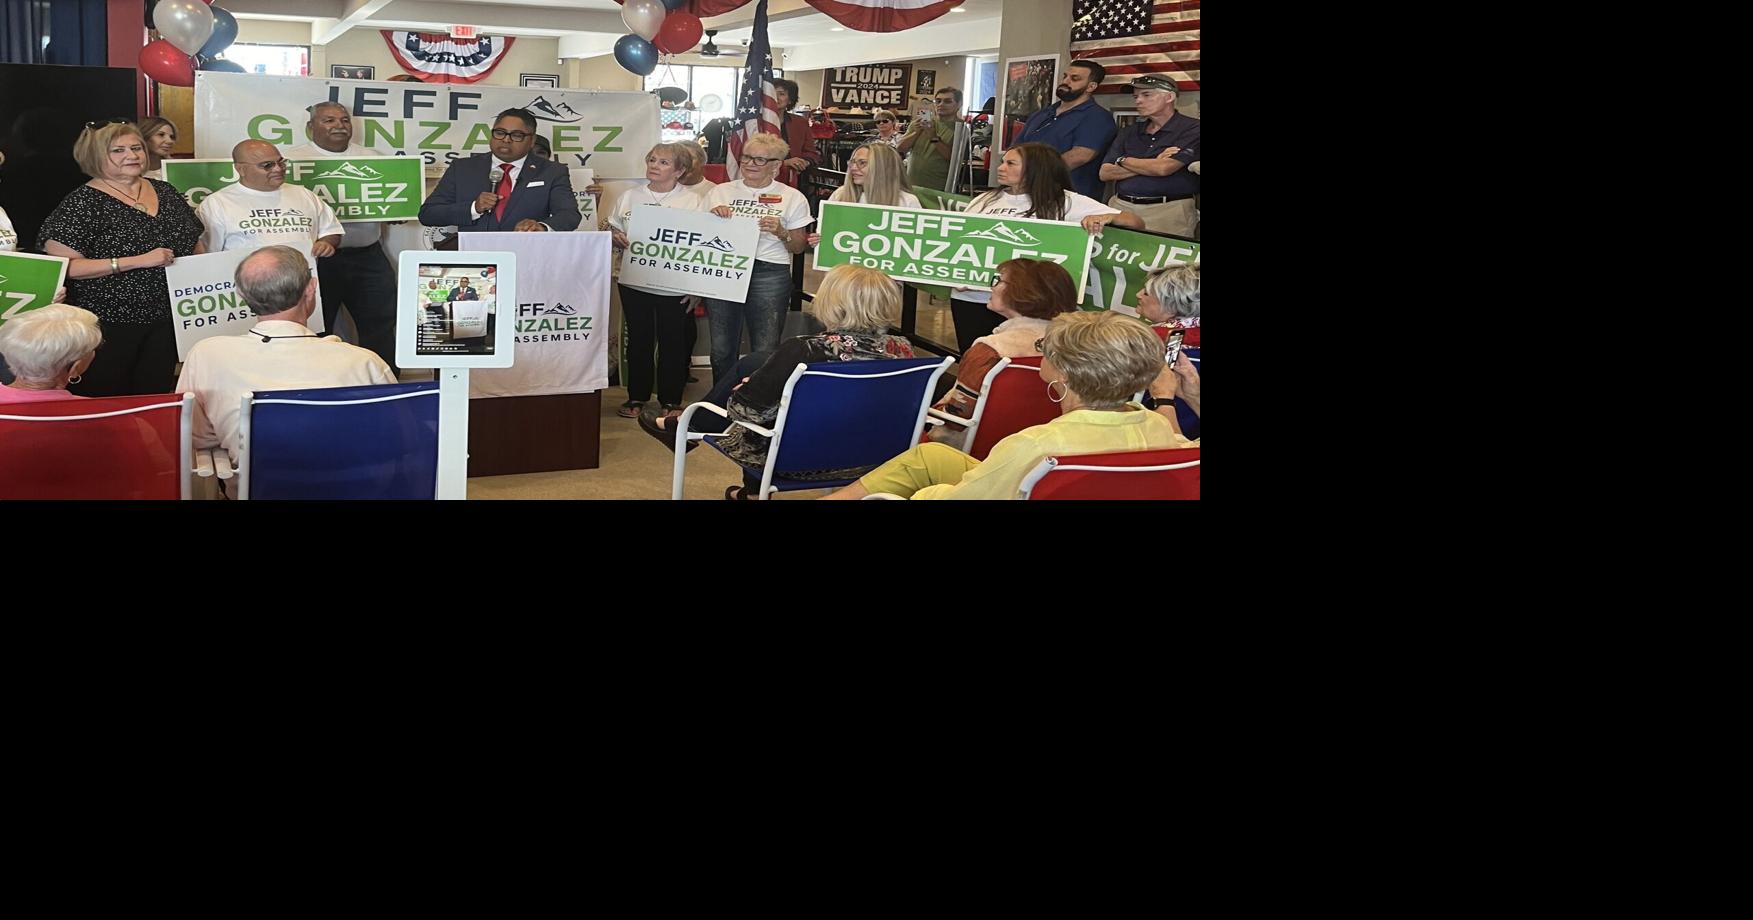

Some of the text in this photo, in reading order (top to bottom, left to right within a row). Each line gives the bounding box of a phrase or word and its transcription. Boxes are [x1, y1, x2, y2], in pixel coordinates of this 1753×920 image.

[833, 66, 903, 84] TRUMP
[831, 88, 902, 104] VANCE
[247, 114, 623, 152] GNZAEZ
[249, 209, 281, 217] JEFF
[239, 218, 312, 229] GONZALEZ
[868, 211, 966, 238] JEFF
[649, 228, 702, 246] JEFF
[630, 241, 749, 270] GONZALEZ
[850, 256, 895, 271] FOR
[1107, 244, 1141, 264] for
[1139, 244, 1200, 271] JE
[630, 256, 743, 280] FOR ASSEMBLY
[175, 281, 236, 297] DEMOCR
[183, 316, 217, 330] FOR
[515, 317, 592, 332] NZALEZ
